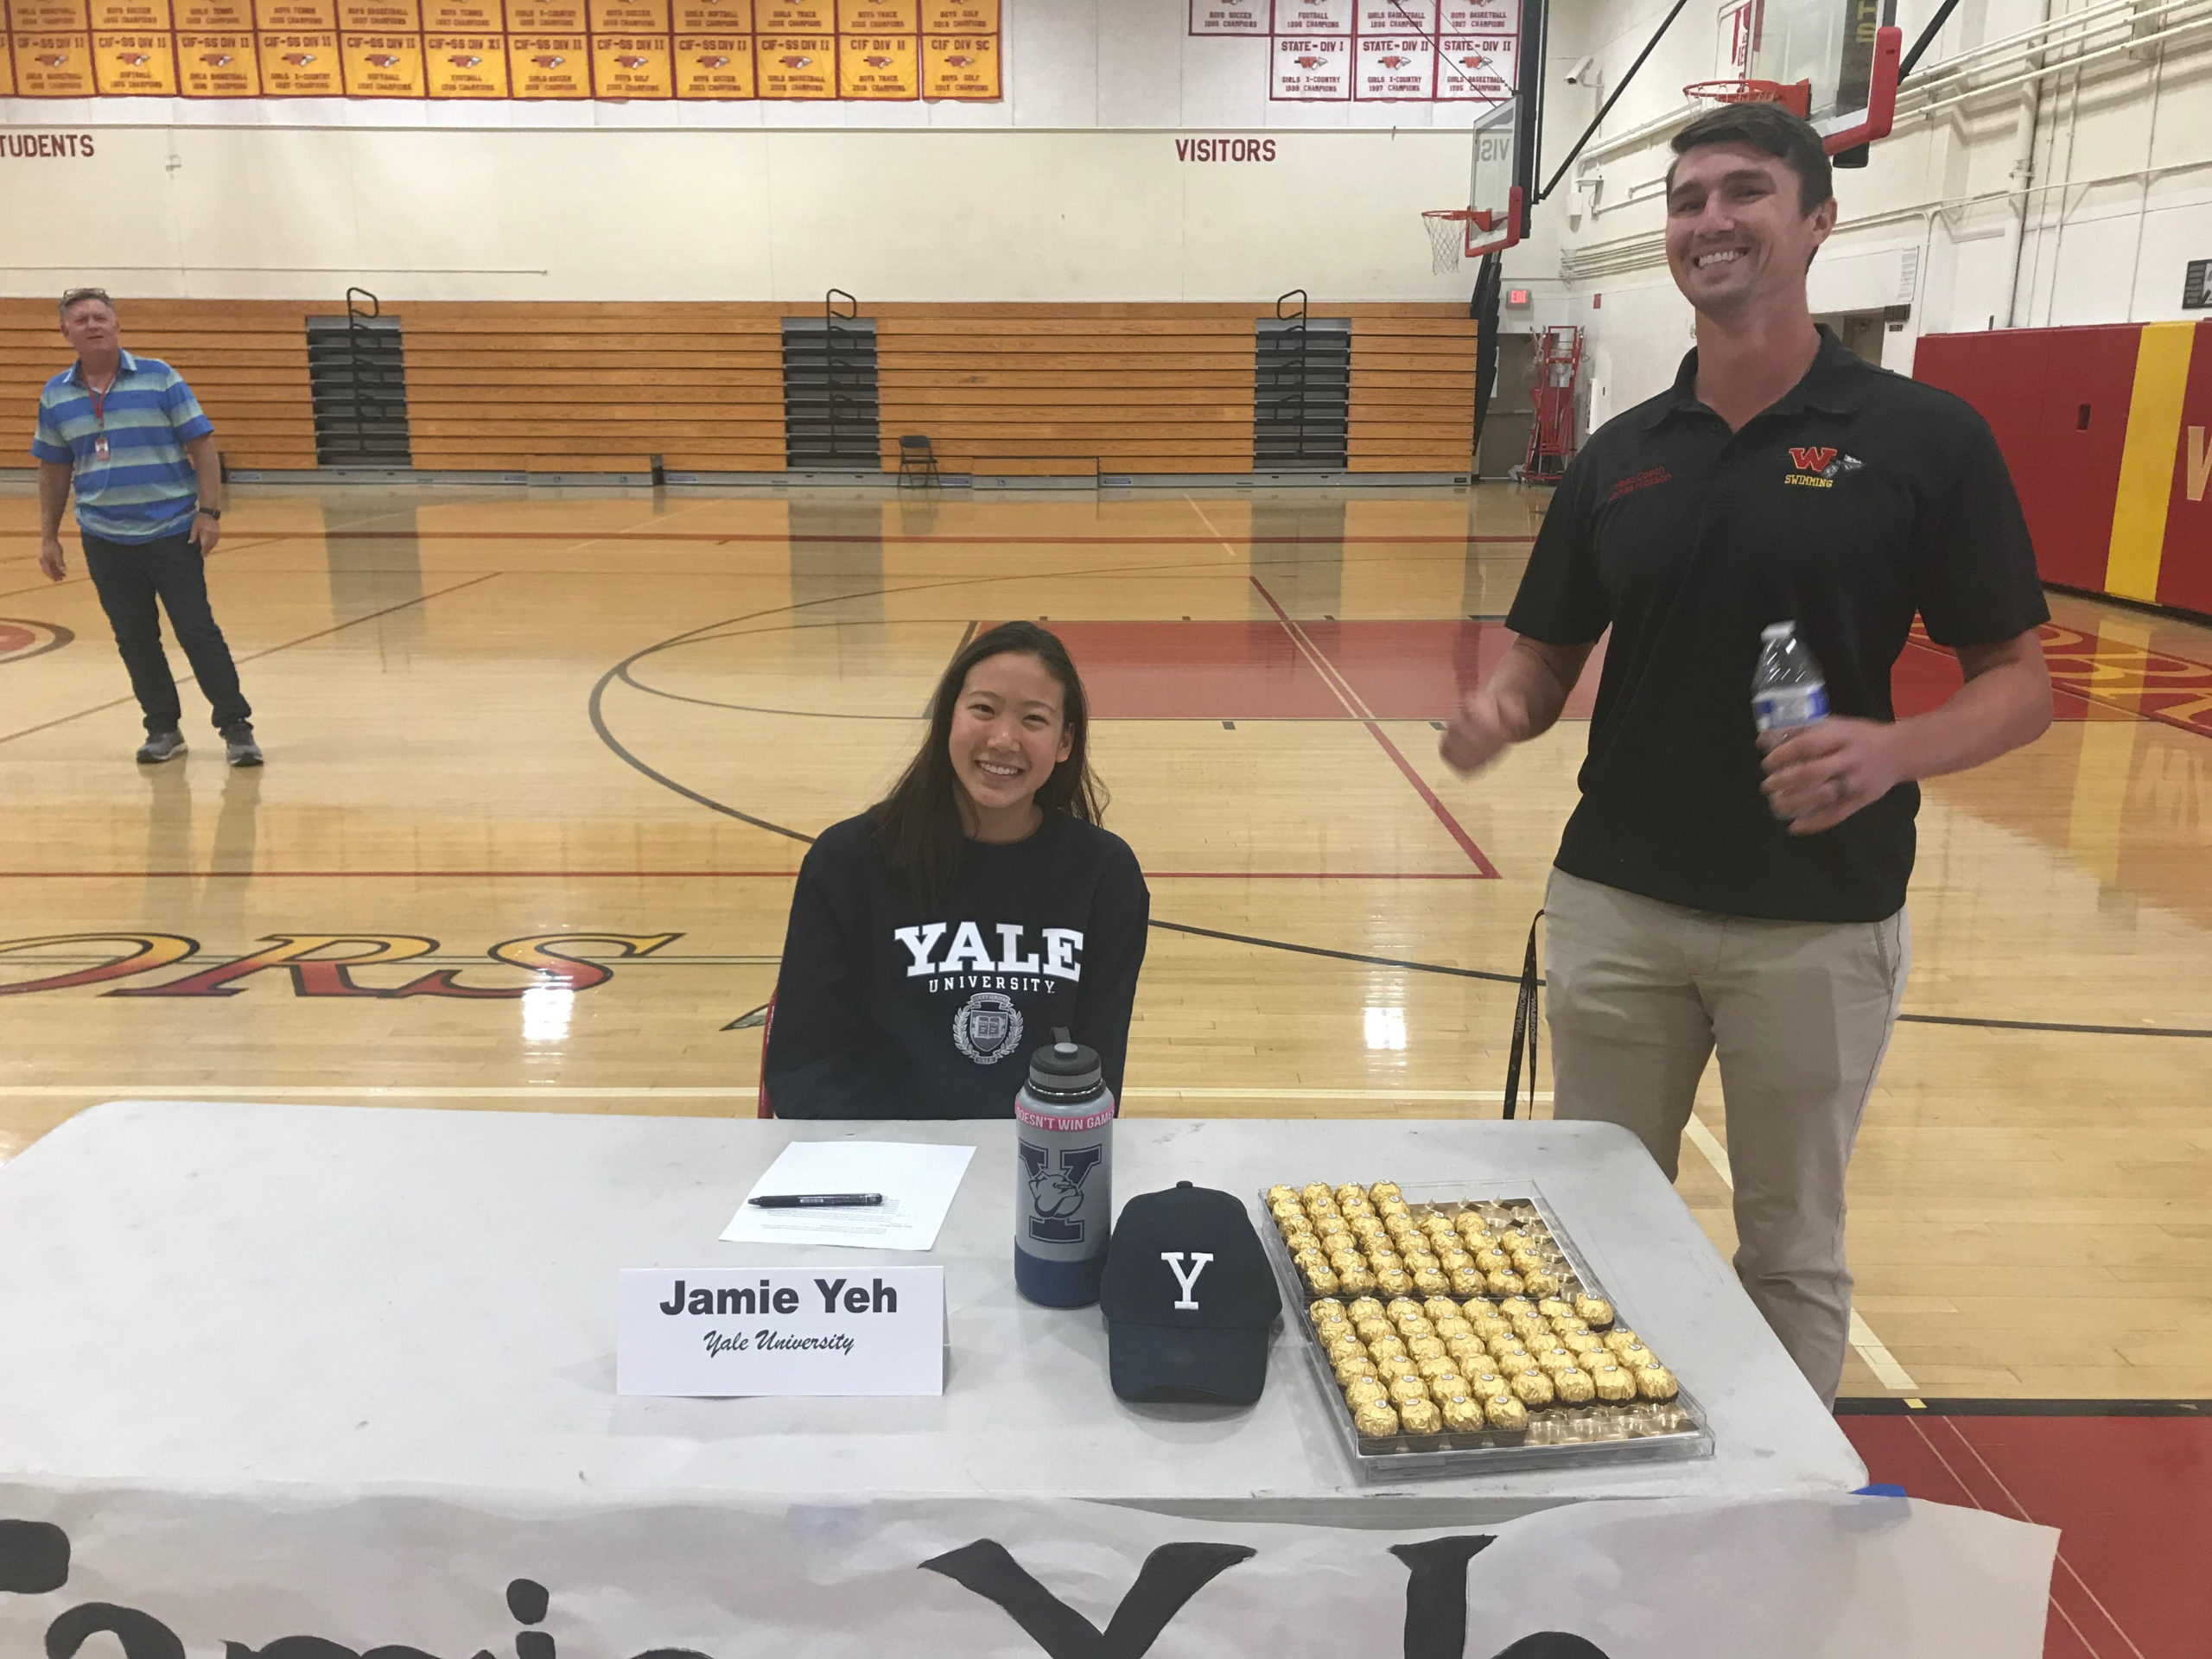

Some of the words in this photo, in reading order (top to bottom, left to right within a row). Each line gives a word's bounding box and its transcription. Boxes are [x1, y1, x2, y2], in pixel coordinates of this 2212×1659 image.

[850, 40, 868, 50] CIF
[873, 40, 891, 50] DIV
[931, 40, 950, 50] CIF
[954, 40, 971, 50] DIV
[976, 41, 989, 50] SC
[1175, 139, 1276, 162] VISITORS
[1789, 447, 1837, 473] W
[1784, 474, 1833, 488] SWIMMING
[894, 921, 1084, 982] YALE
[929, 976, 1054, 994] UNIVERSITY
[1058, 1119, 1083, 1130] WIN
[1160, 1252, 1214, 1310] Y
[659, 1279, 798, 1316] Jamie
[814, 1278, 898, 1313] Yeh
[702, 1330, 749, 1357] Yale
[754, 1329, 855, 1356] University
